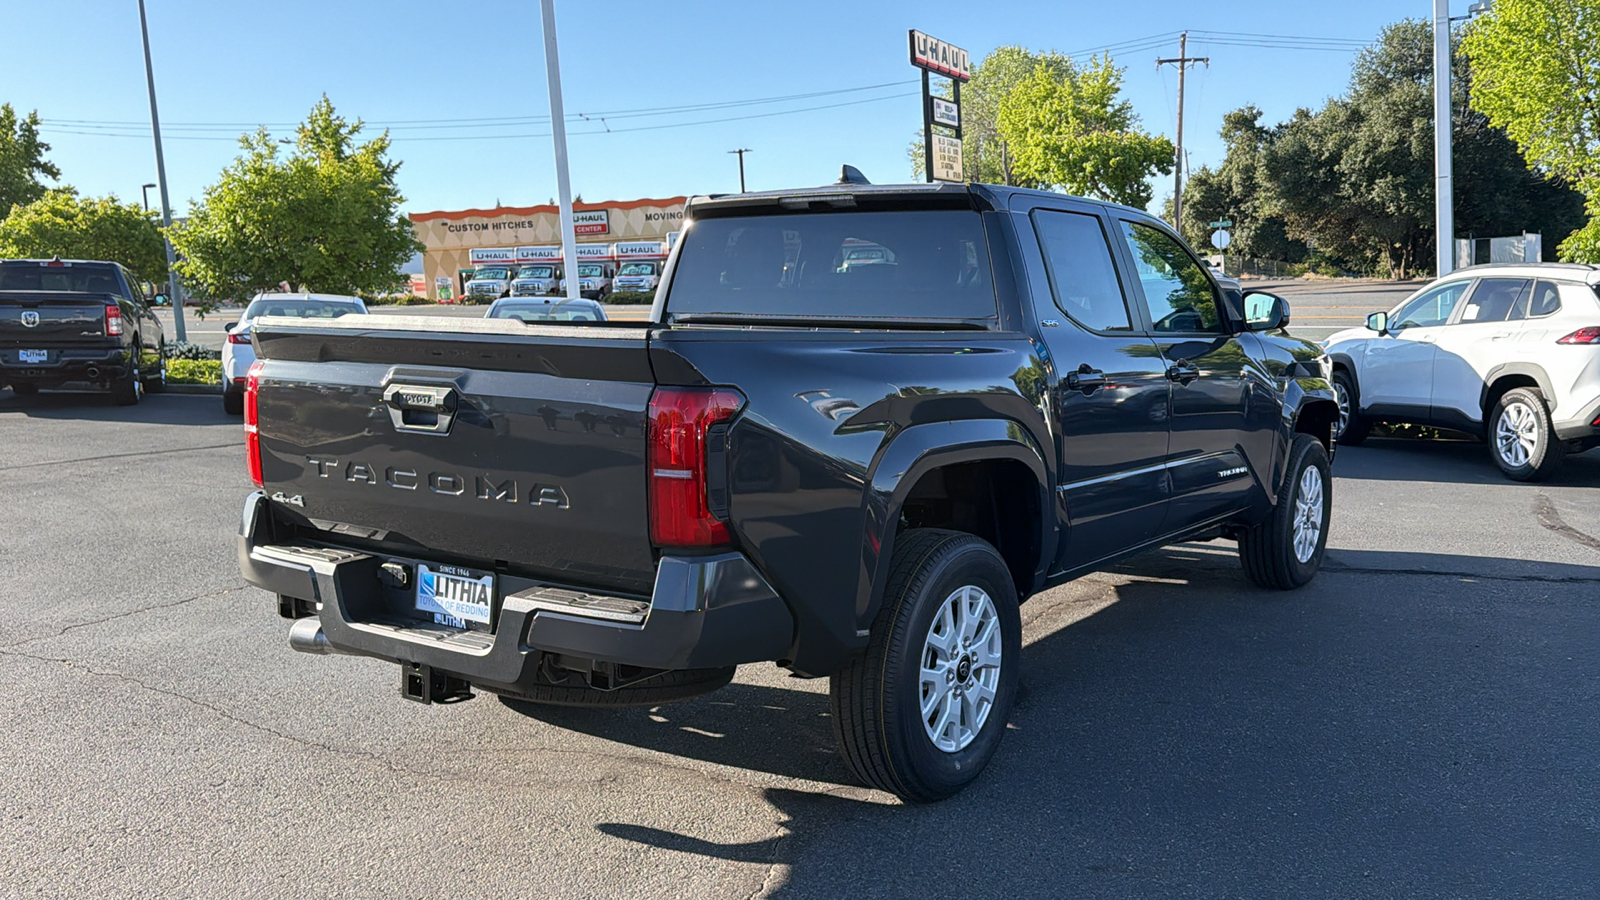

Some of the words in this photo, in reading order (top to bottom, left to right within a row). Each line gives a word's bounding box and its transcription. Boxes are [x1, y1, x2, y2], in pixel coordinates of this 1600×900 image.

[645, 212, 683, 221] MOVING
[448, 223, 489, 232] CUSTOM
[492, 220, 533, 230] HITCHES
[403, 394, 433, 405] TOYOTA
[306, 456, 571, 509] TACOMA
[439, 565, 456, 574] SINCE
[457, 568, 470, 576] 1946
[435, 575, 488, 606] LITHIA
[419, 596, 444, 608] TOYOTA
[445, 601, 455, 610] OF
[456, 603, 489, 617] REDDING
[441, 614, 466, 629] LITHIA
